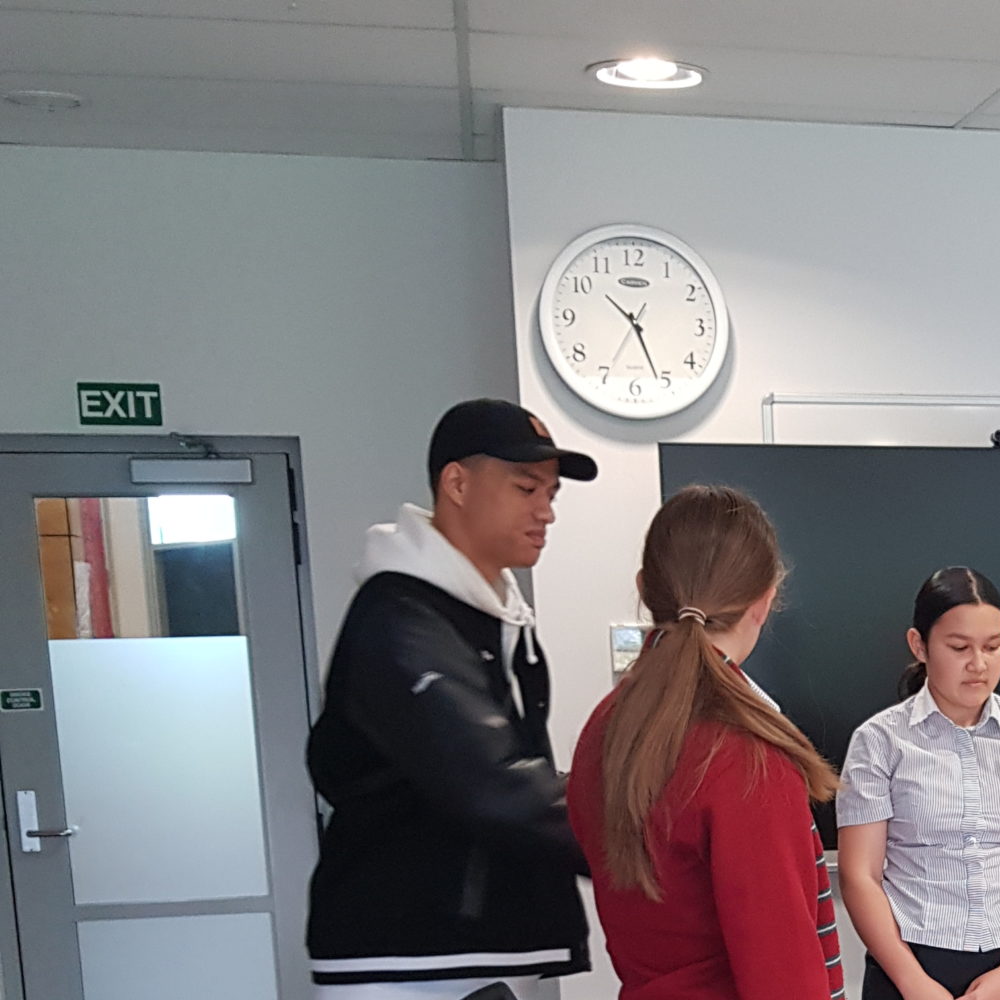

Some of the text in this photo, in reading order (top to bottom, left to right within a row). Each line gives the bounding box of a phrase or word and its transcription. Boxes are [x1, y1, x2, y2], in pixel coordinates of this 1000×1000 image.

[593, 256, 611, 274] 11
[623, 249, 645, 267] 12
[663, 261, 670, 279] 1
[572, 275, 592, 294] 10
[685, 284, 697, 302] 2
[562, 308, 576, 327] 9
[694, 318, 705, 337] 3
[572, 343, 586, 362] 8
[683, 352, 697, 370] 4
[598, 366, 610, 385] 7
[660, 371, 671, 389] 5
[629, 378, 642, 396] 6
[80, 390, 159, 418] EXIT
